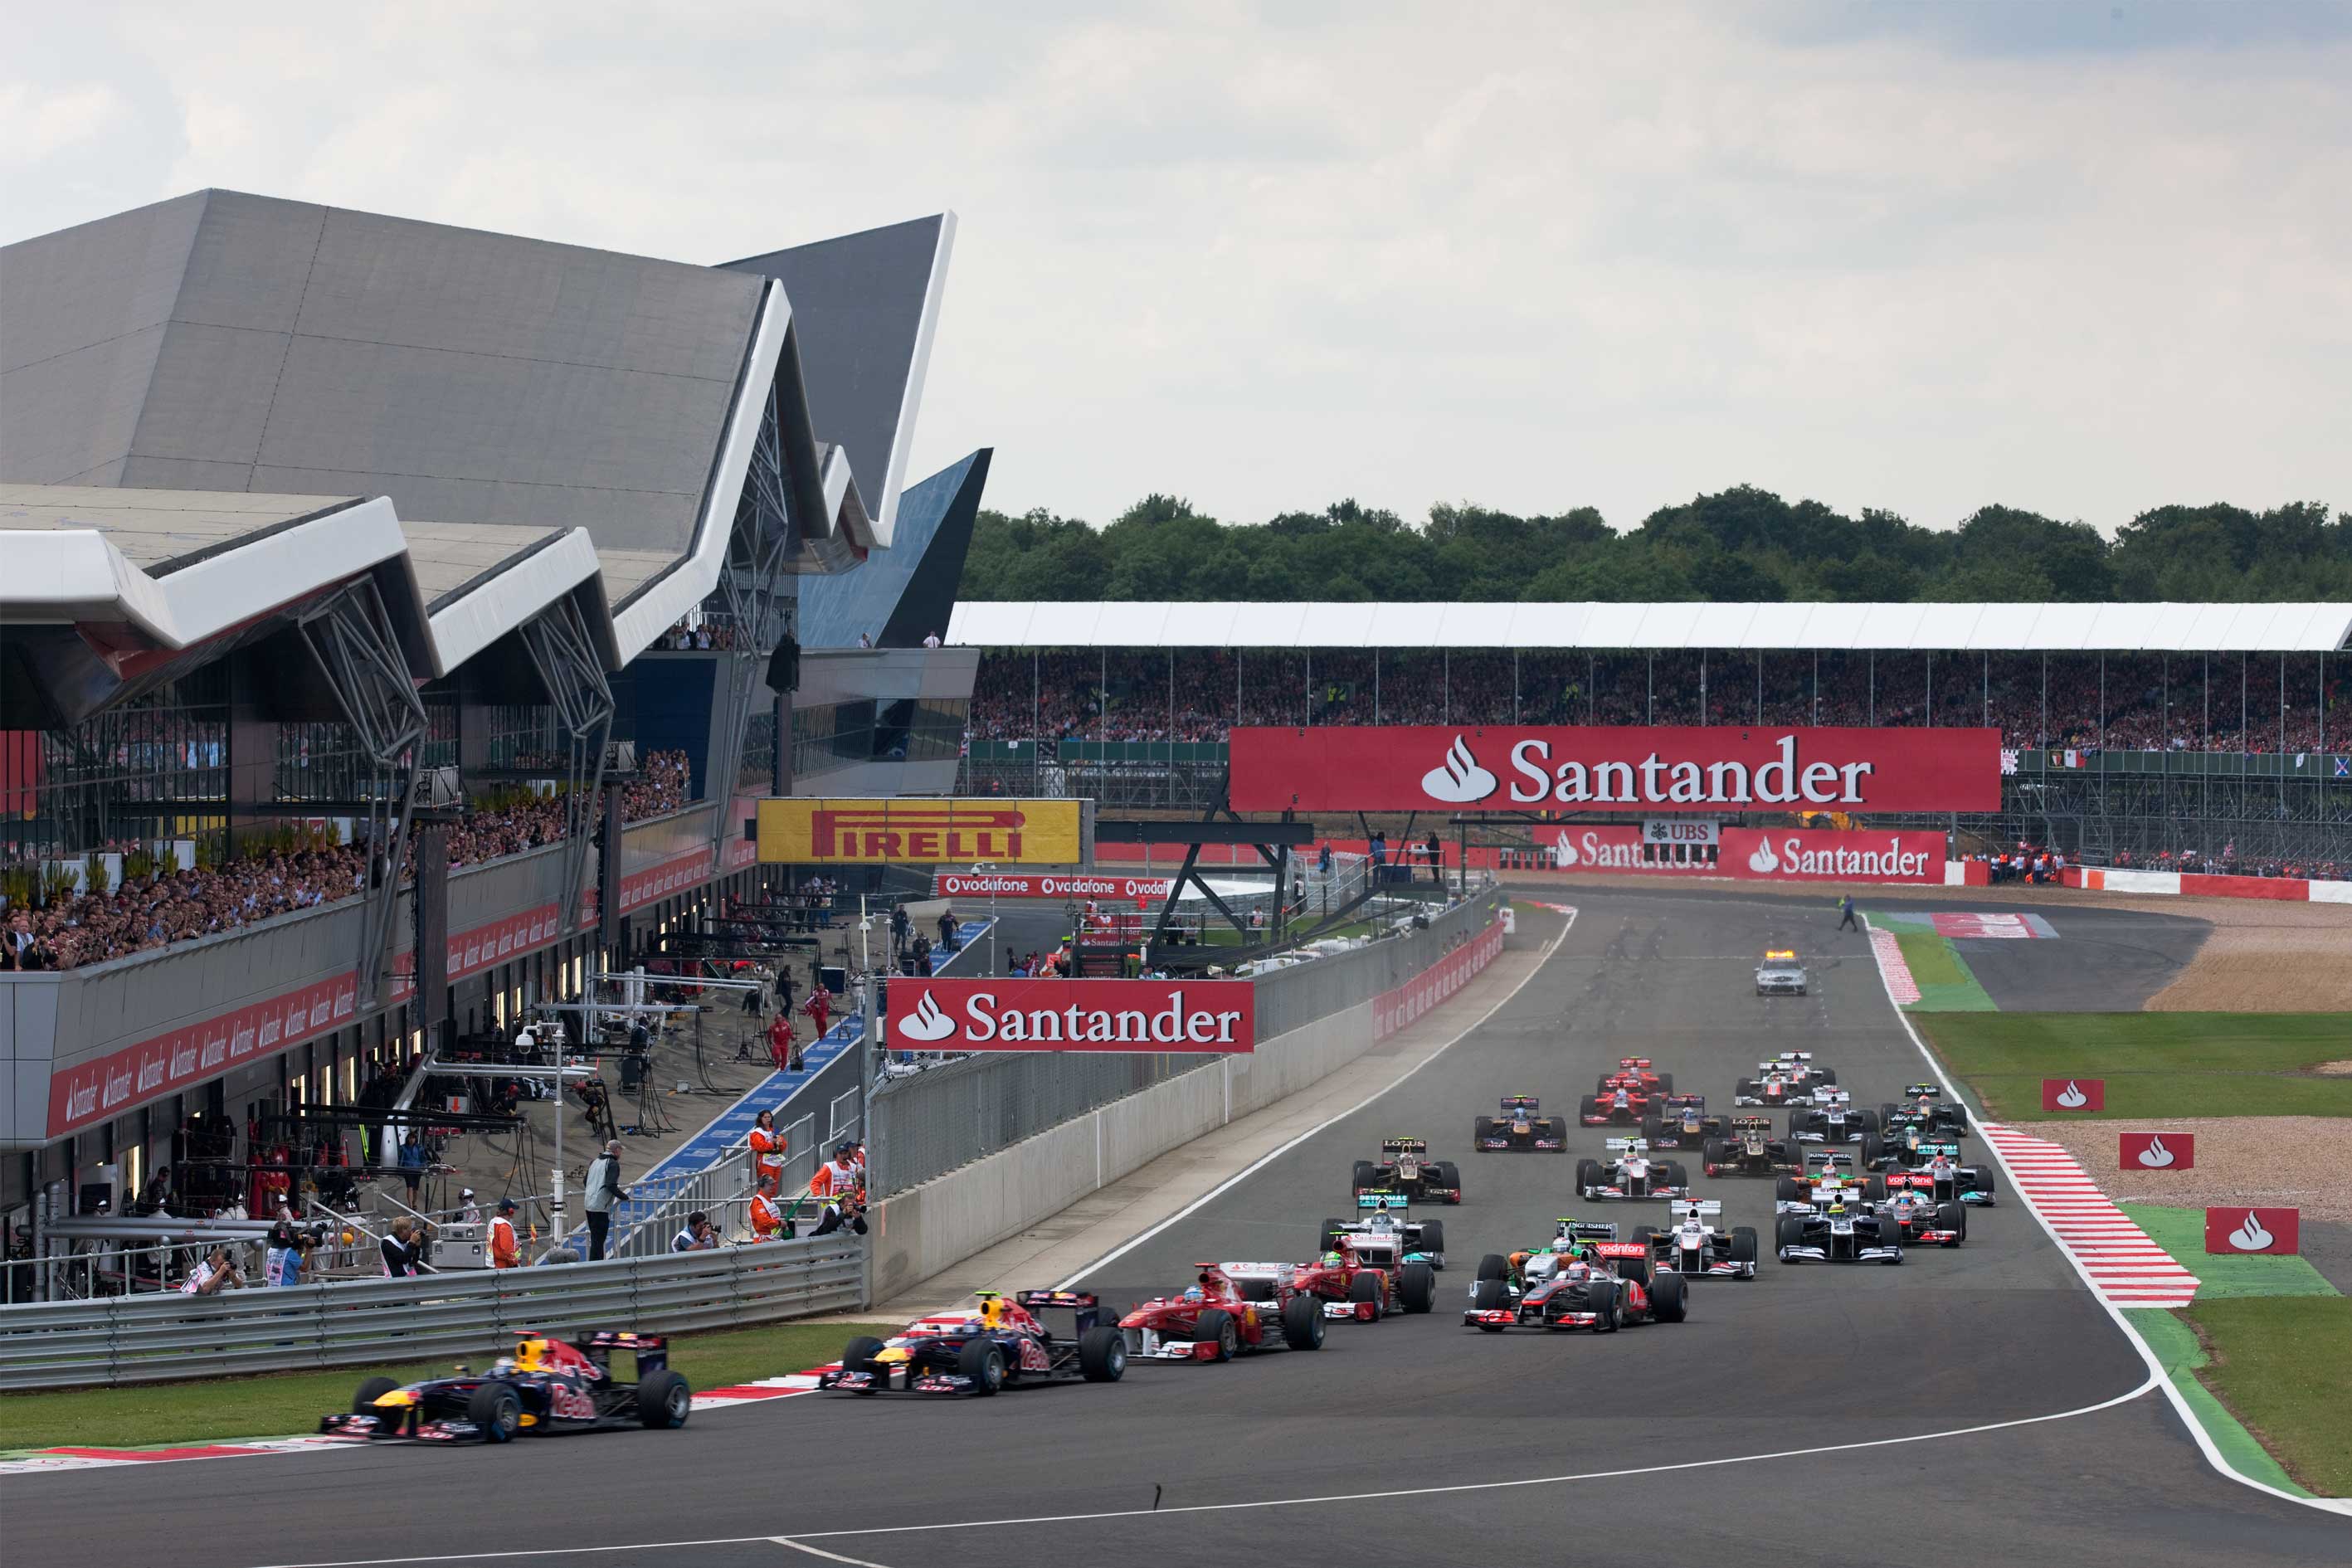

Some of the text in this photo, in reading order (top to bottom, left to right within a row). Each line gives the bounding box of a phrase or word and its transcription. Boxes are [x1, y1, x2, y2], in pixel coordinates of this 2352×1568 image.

[1510, 735, 1872, 803] Santander
[811, 811, 1025, 858] PIRELLI
[1670, 823, 1709, 840] UBS
[1581, 831, 1720, 870] Santnd
[1783, 836, 1929, 876] Santander
[961, 878, 1029, 893] vodafone
[1055, 879, 1115, 894] vodafone
[1137, 879, 1168, 895] vodaf
[1091, 937, 1132, 946] Santanr
[966, 991, 1240, 1043] Santander
[1888, 1176, 1933, 1184] vodfone
[1354, 1234, 1393, 1242] Satande
[1597, 1244, 1645, 1254] vodafon
